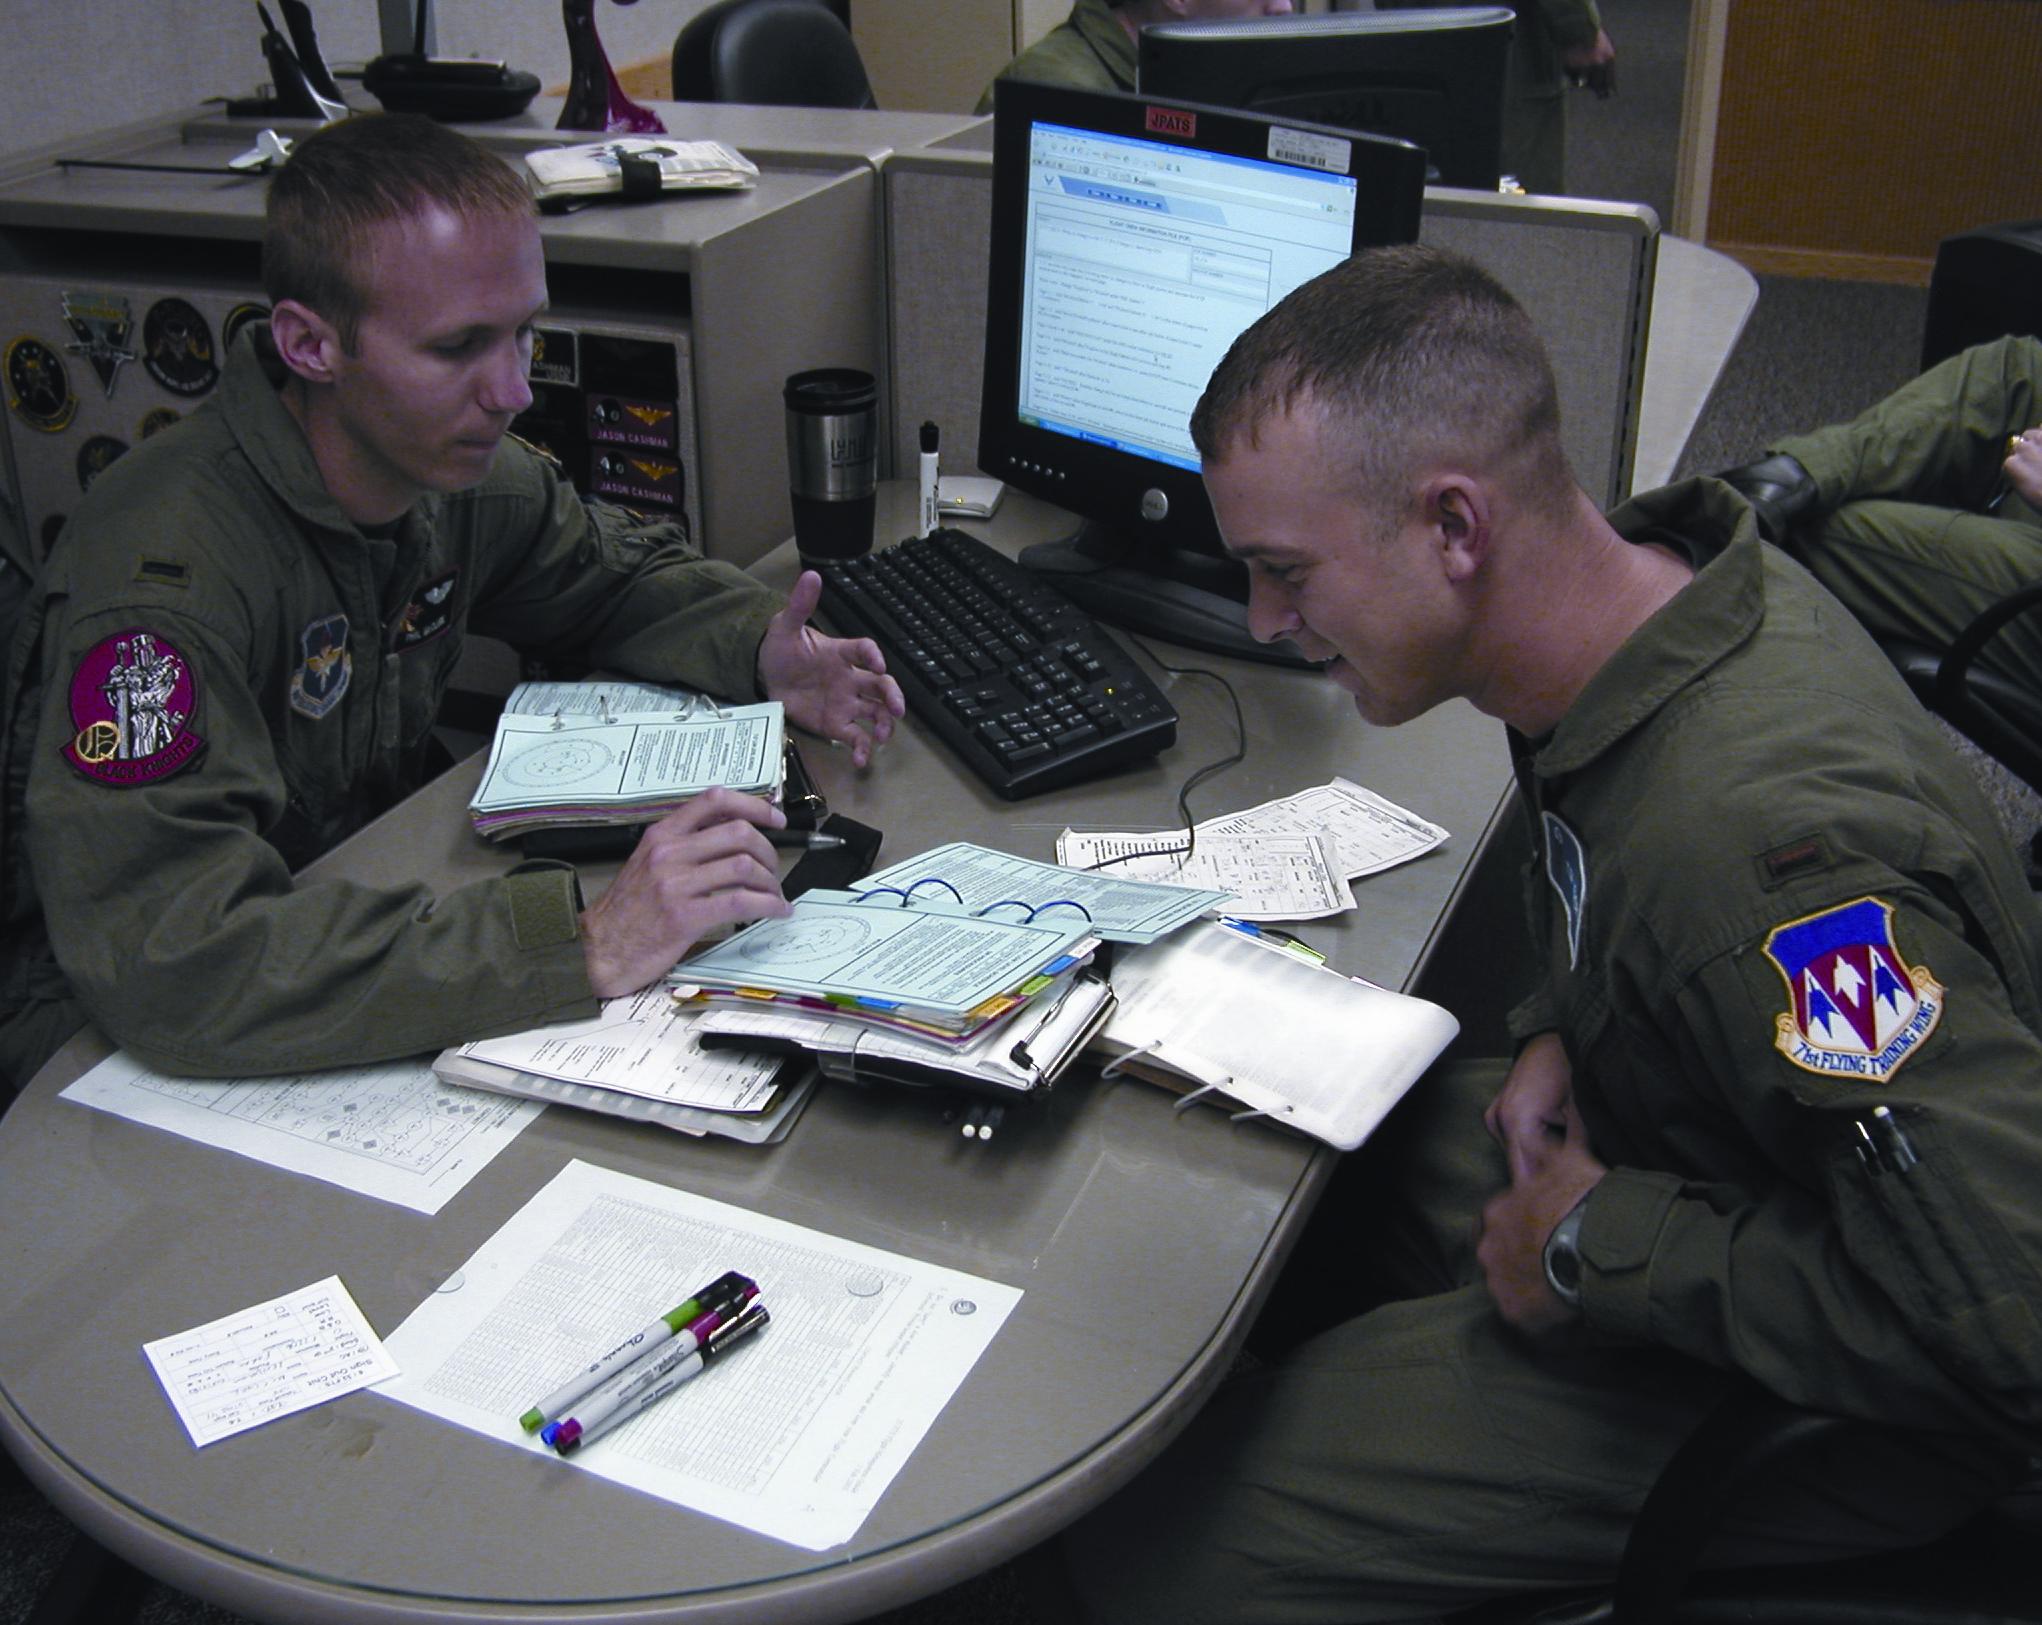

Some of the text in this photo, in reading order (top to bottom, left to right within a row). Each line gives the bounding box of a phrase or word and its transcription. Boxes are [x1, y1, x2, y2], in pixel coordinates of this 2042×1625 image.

[1151, 111, 1192, 132] JPATS
[597, 429, 669, 448] JASON CASHMAN
[599, 480, 674, 503] JASON CASHMAN
[95, 761, 136, 778] BLACK
[1820, 1052, 1866, 1075] FLYING
[1870, 1028, 1918, 1075] TRAINING
[1914, 999, 1937, 1039] WING
